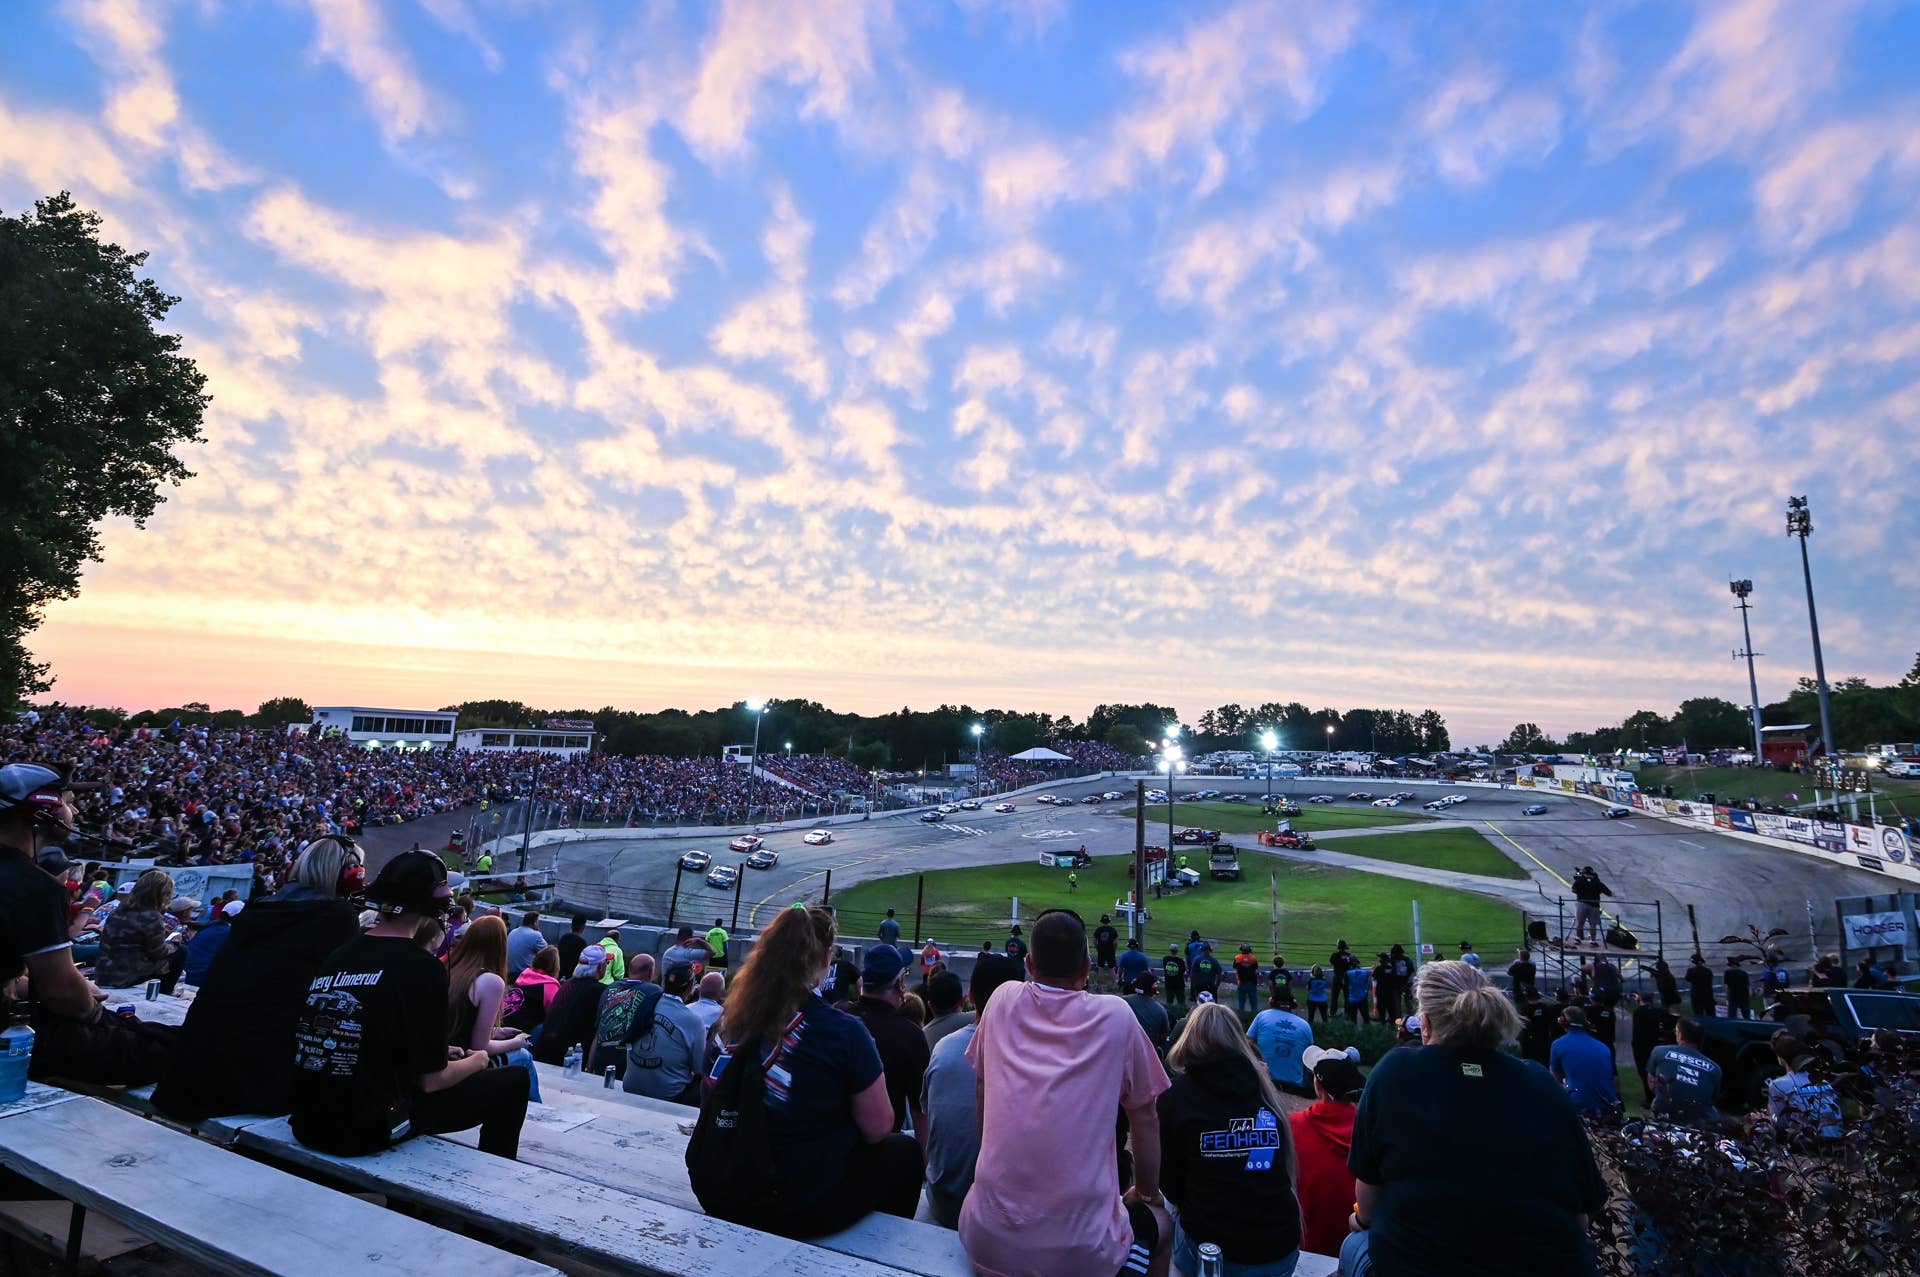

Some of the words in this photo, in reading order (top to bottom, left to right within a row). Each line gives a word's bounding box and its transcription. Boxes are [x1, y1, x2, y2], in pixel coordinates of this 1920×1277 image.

[309, 976, 333, 992] very
[333, 970, 383, 987] Linnerud
[1231, 1120, 1251, 1133] Luke
[1203, 1131, 1278, 1149] FENHAUS
